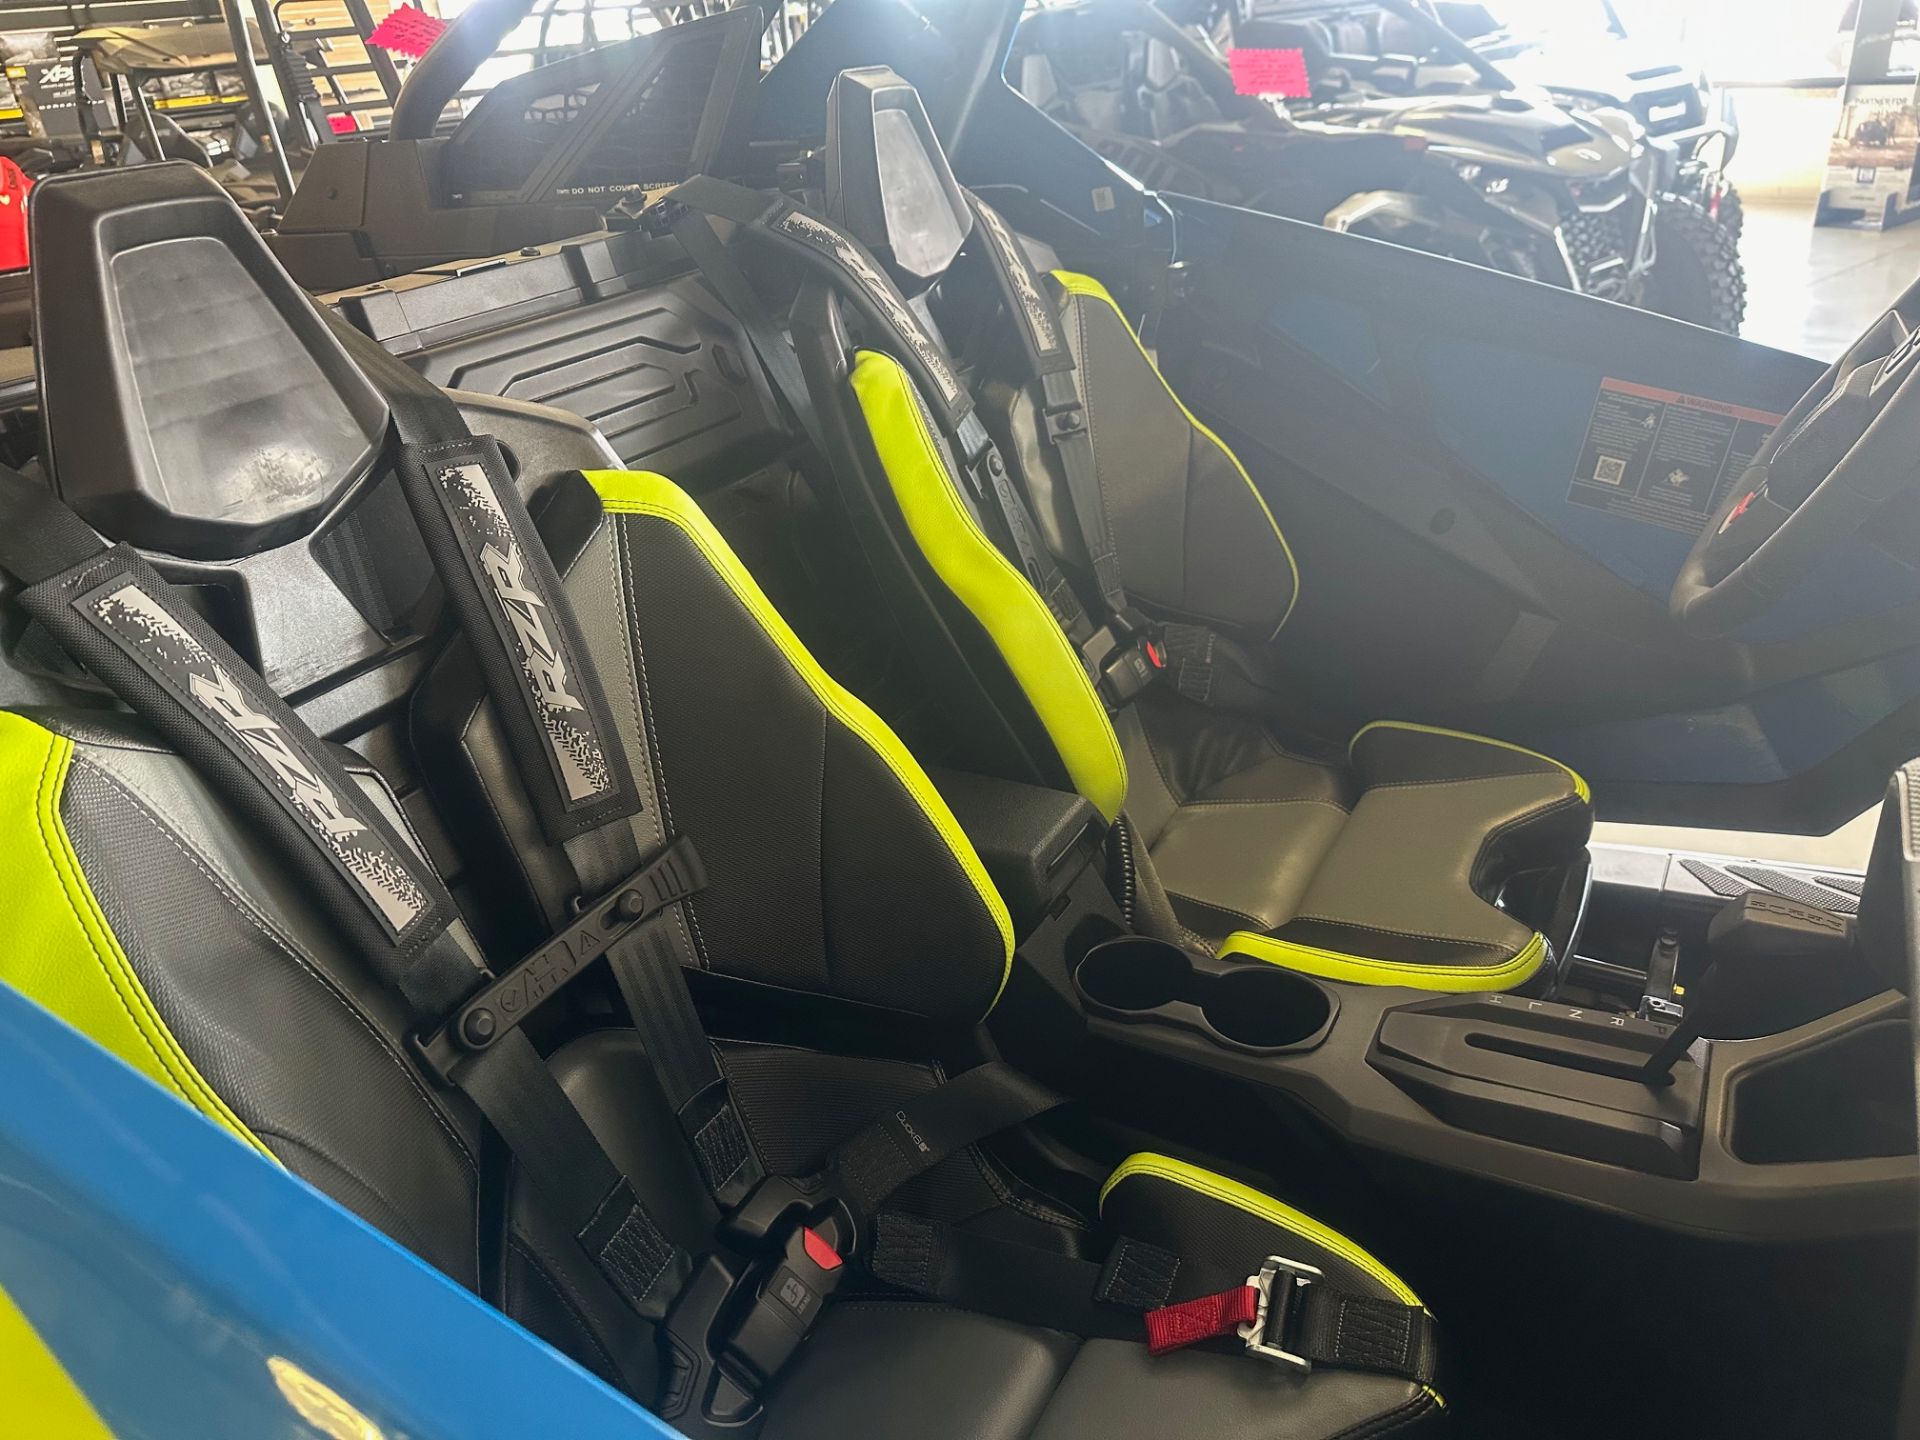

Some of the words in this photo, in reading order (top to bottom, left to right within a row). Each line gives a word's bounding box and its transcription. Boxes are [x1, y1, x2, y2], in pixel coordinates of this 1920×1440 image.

[571, 187, 584, 195] DO
[473, 541, 585, 711] RZR
[189, 664, 368, 834] RZR
[1490, 994, 1504, 1004] H
[1528, 1001, 1542, 1010] L
[1568, 1008, 1584, 1020] N
[1609, 1016, 1625, 1027] R
